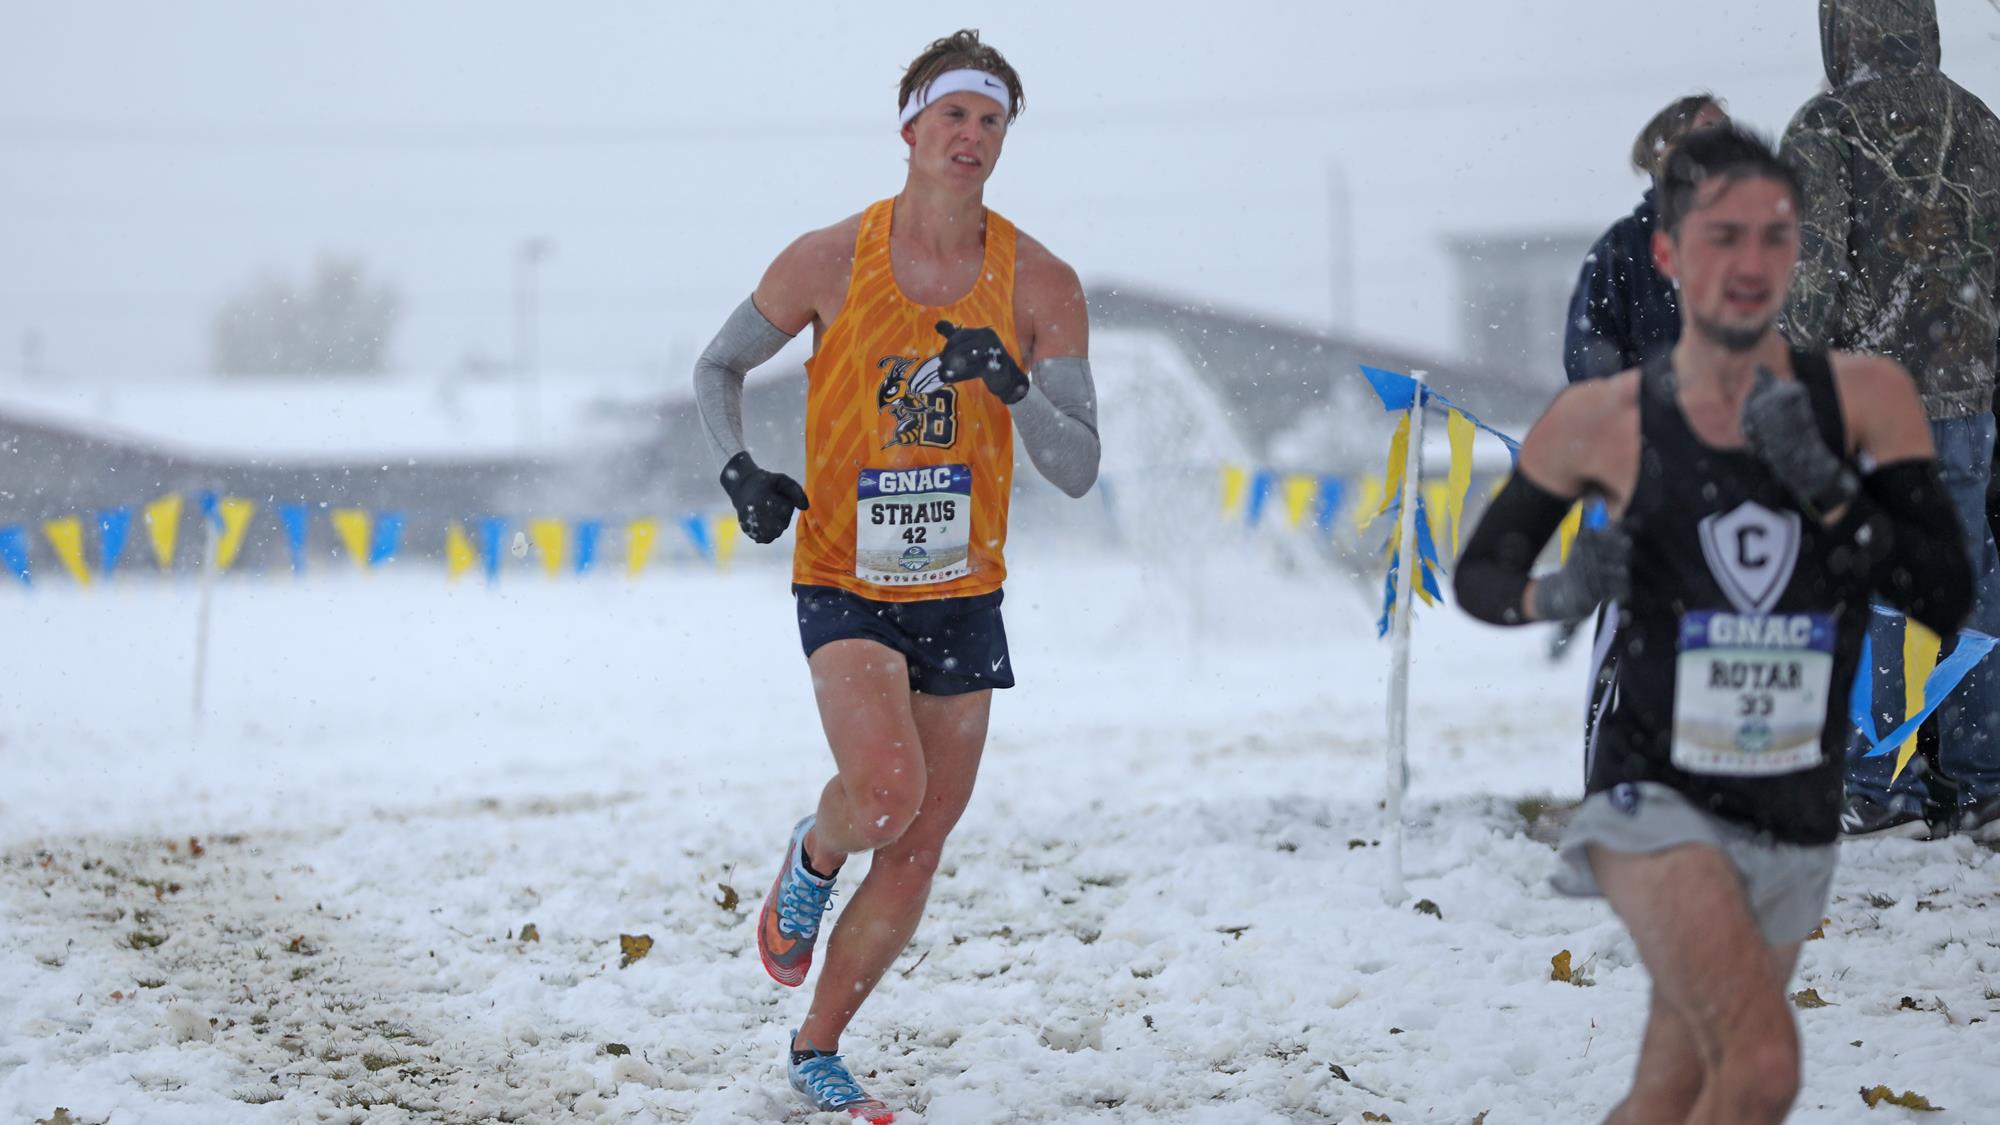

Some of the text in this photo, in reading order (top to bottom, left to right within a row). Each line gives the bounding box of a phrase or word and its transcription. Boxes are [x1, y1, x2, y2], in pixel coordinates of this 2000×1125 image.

[879, 467, 951, 493] GNAC
[871, 500, 956, 525] STRAUS
[902, 526, 927, 544] 42
[1737, 525, 1767, 569] C
[1708, 612, 1812, 648] GNAC
